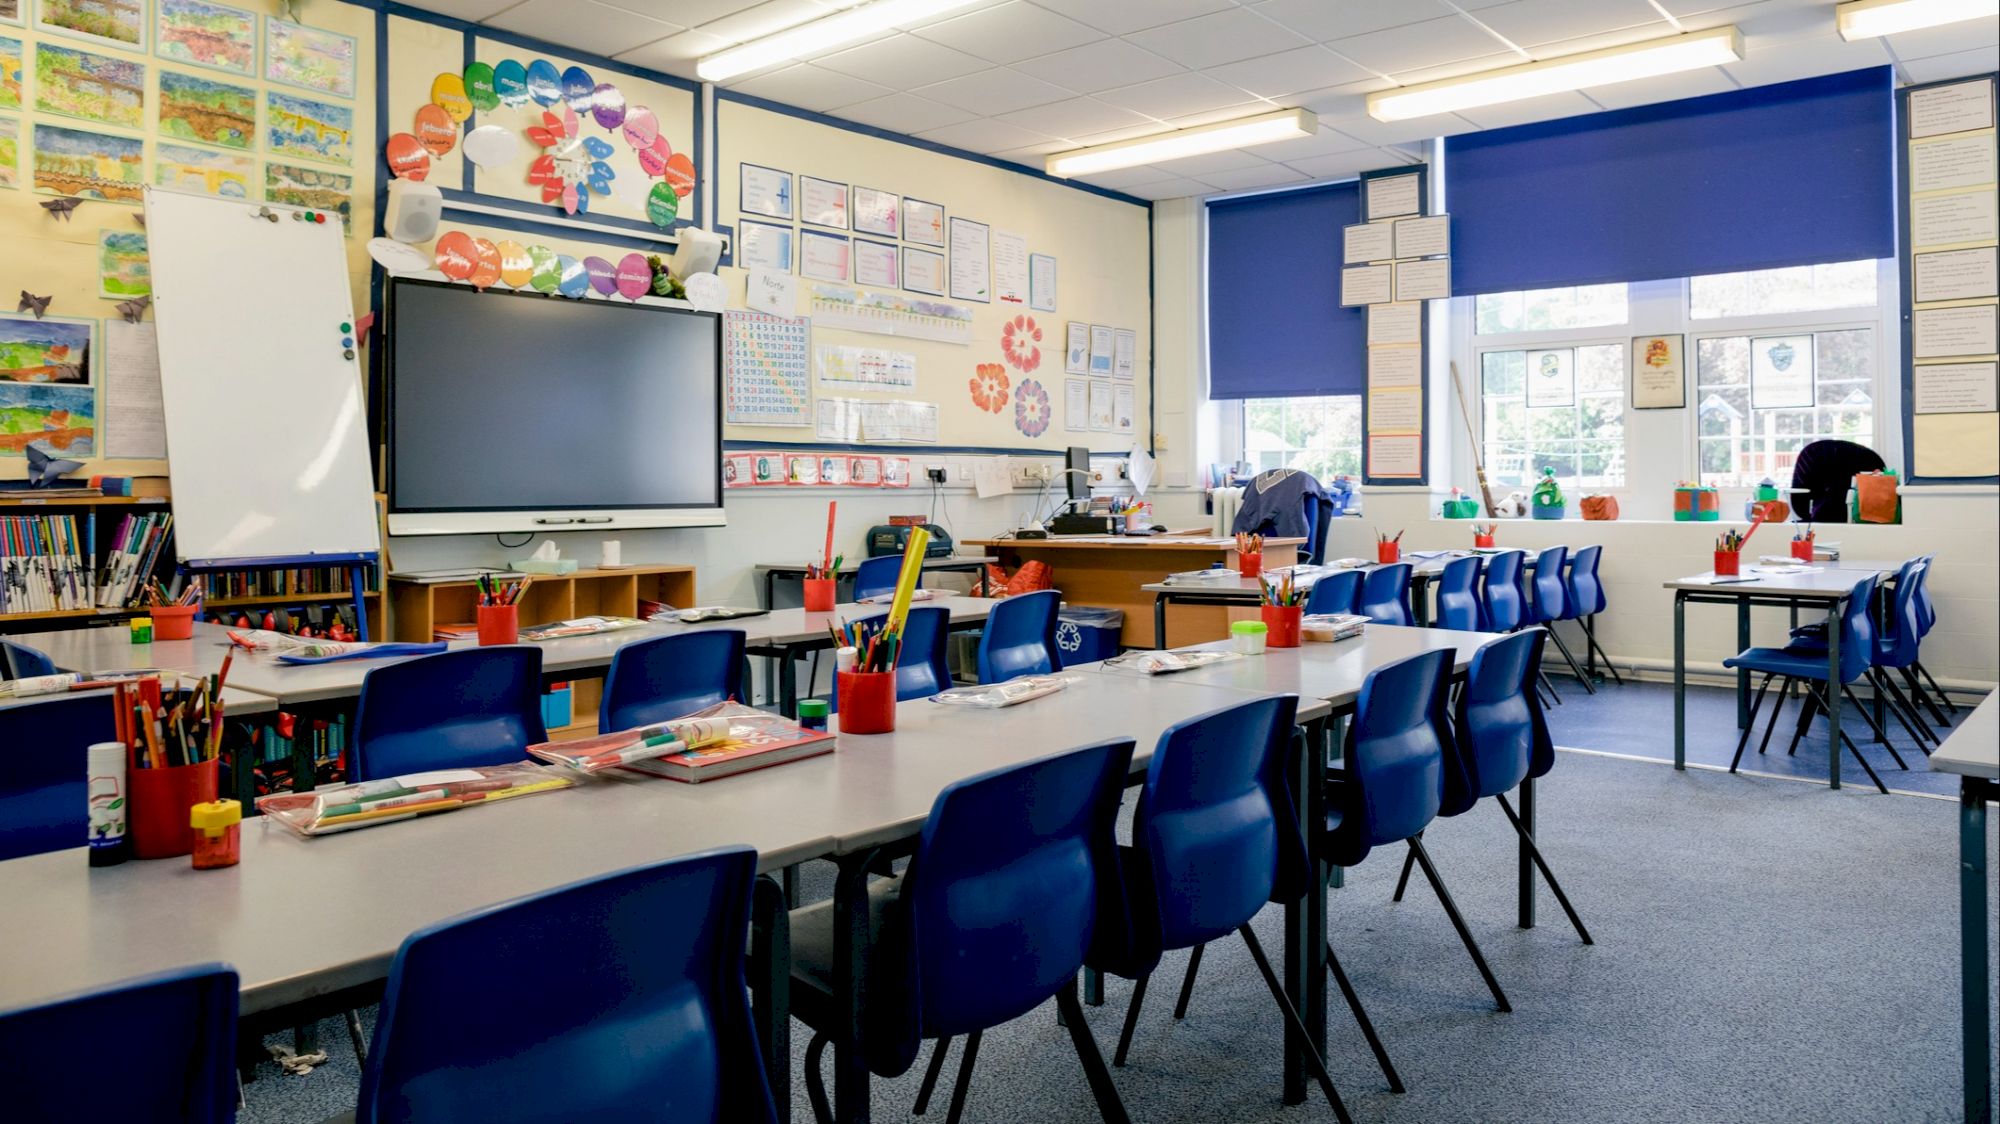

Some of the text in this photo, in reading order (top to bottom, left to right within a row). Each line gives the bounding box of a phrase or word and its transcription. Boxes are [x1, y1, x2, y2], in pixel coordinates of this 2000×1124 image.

[474, 80, 492, 92] abril
[501, 78, 524, 91] mayo
[422, 122, 452, 136] febrero
[650, 196, 676, 211] diciembre
[619, 272, 649, 284] domingo
[762, 275, 785, 292] Norte
[726, 466, 735, 478] R
[760, 464, 768, 476] U
